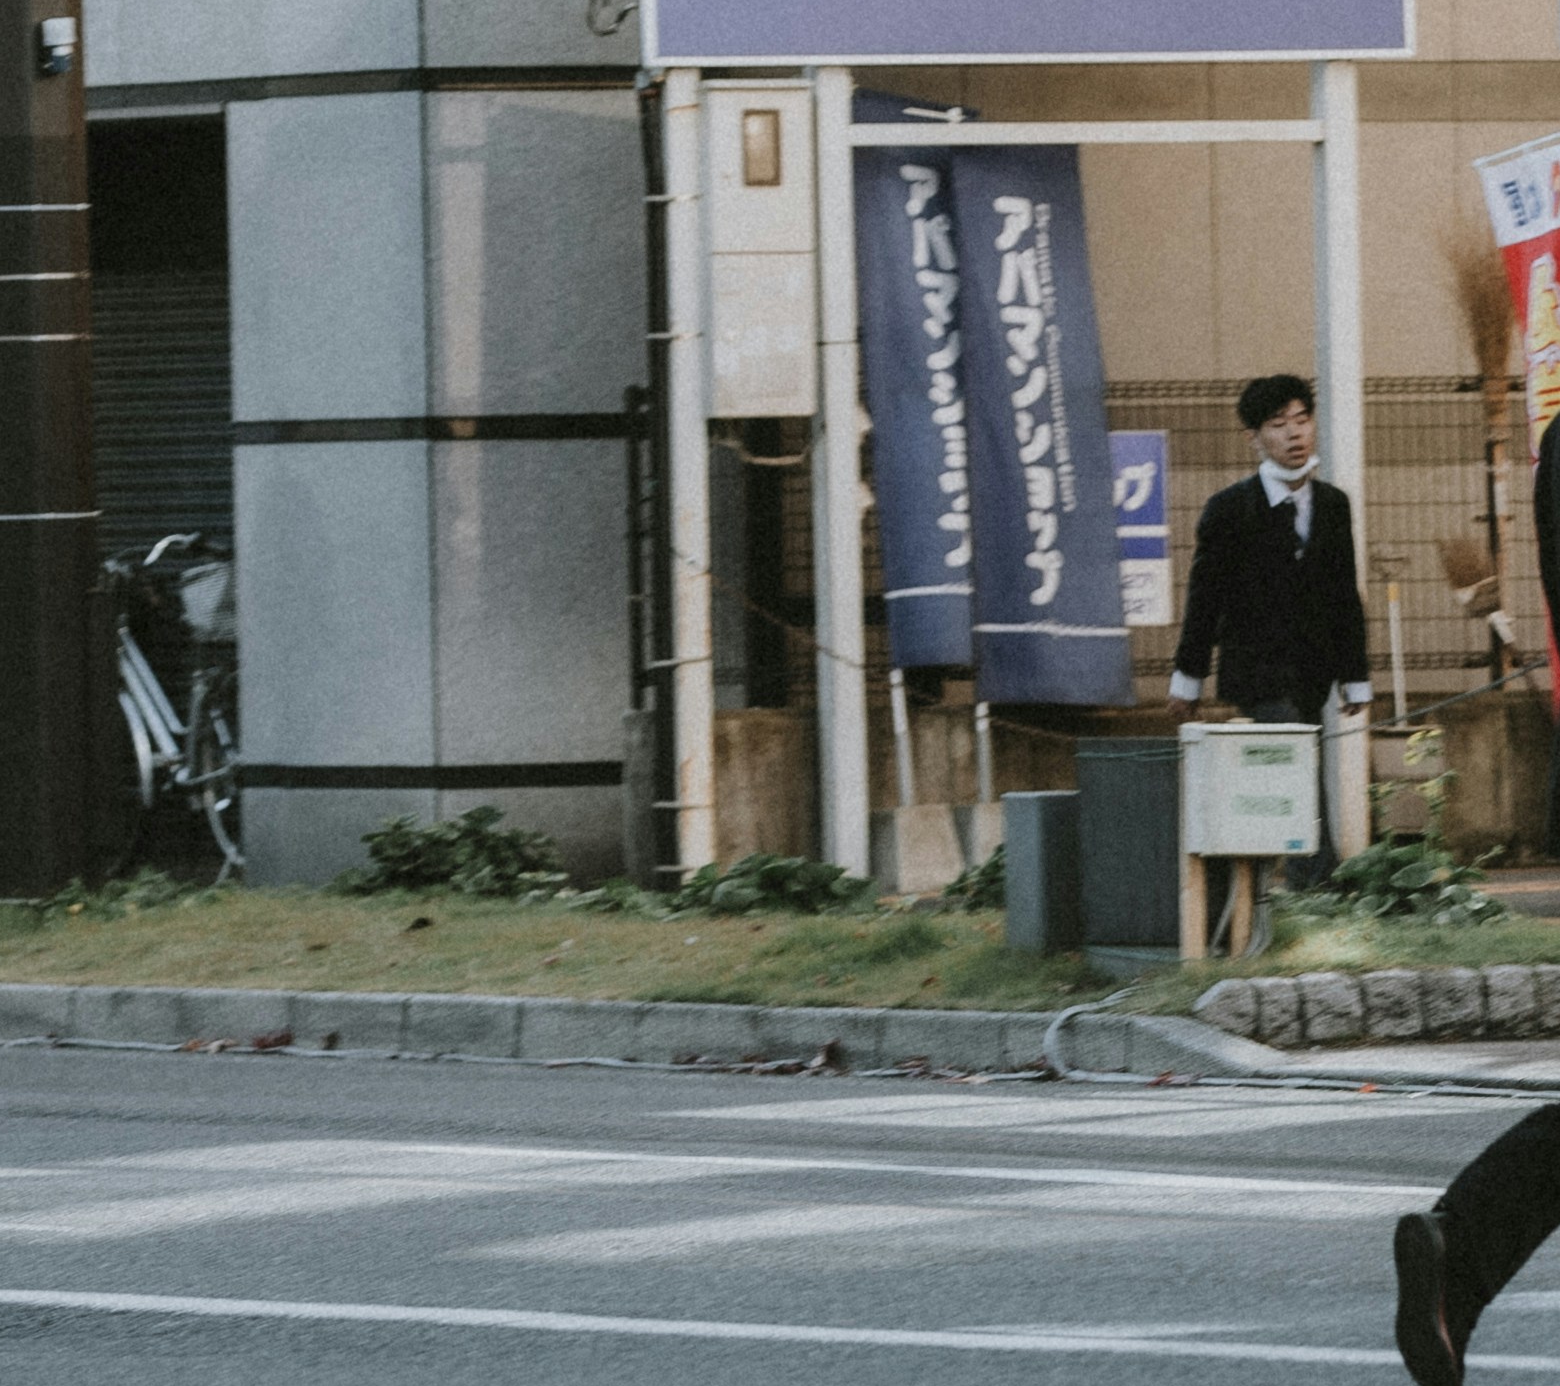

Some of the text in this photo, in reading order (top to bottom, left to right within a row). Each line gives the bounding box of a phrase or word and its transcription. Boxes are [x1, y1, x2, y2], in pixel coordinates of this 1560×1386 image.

[993, 195, 1065, 607] アパマンショップ
